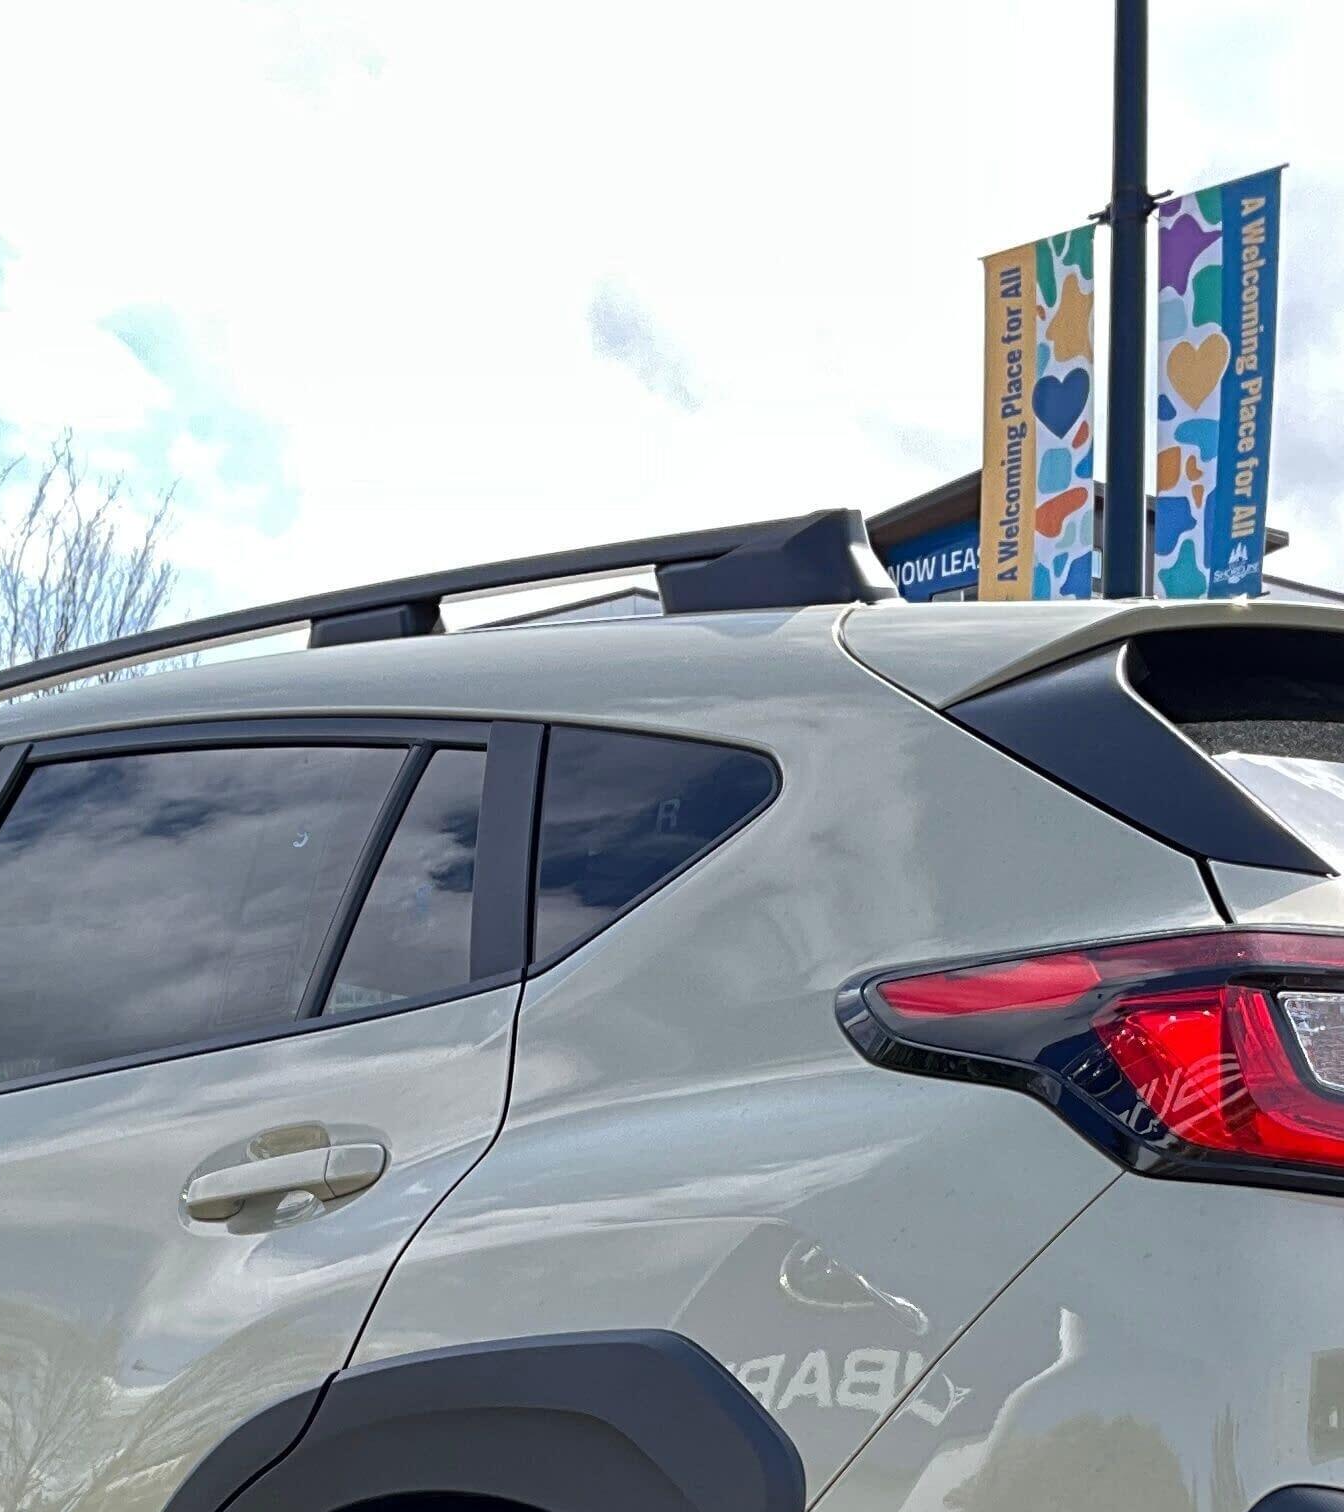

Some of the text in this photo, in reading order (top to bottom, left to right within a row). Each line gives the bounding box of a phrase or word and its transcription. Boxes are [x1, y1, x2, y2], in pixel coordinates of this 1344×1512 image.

[1240, 196, 1266, 217] A
[1236, 217, 1266, 376] Welcoming
[997, 265, 1028, 582] A Welcoming Place for All
[1237, 376, 1263, 454] Place
[1234, 456, 1259, 498] for
[1231, 505, 1257, 539] All
